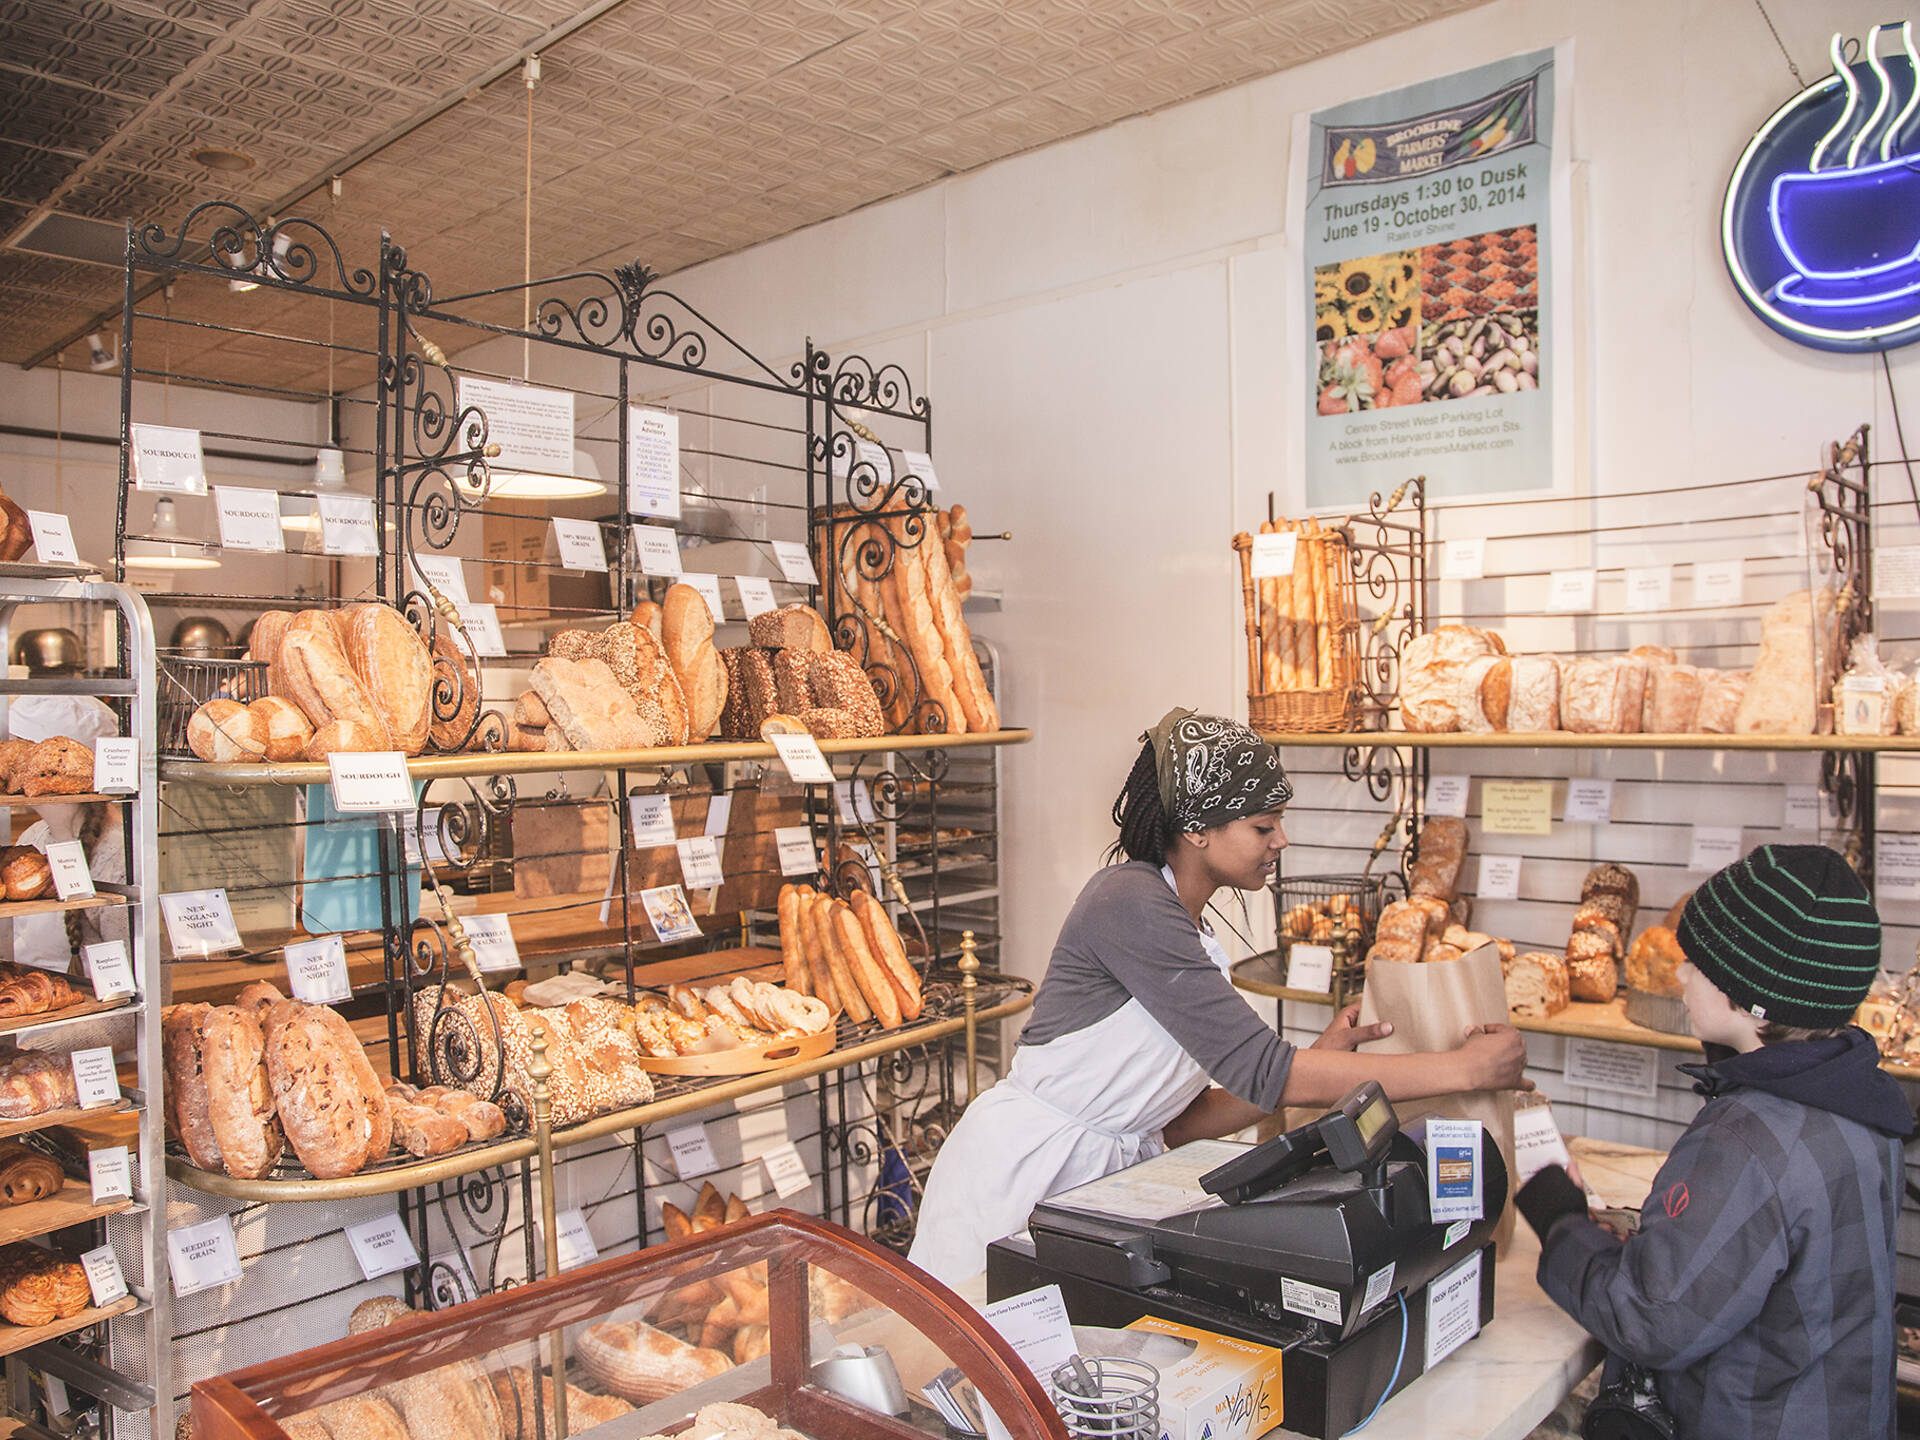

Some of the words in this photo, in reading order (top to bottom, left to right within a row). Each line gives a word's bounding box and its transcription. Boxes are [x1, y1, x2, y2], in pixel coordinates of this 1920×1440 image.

[1387, 119, 1462, 147] BROOKLINE
[1397, 133, 1449, 157] FARMERS'
[1400, 152, 1444, 173] MARKET
[1324, 190, 1410, 221] Thursdays
[1416, 178, 1452, 201] 1:30
[1457, 175, 1474, 193] to
[1481, 163, 1528, 187] Dusk
[1323, 220, 1358, 242] June
[1364, 216, 1380, 234] 19
[1393, 202, 1455, 228] October
[1460, 194, 1482, 215] 30,
[1487, 184, 1526, 208] 2014
[1387, 229, 1411, 243] Rain
[1413, 227, 1423, 238] or
[1425, 221, 1456, 235] Shine
[1344, 422, 1378, 436] Centre
[1380, 419, 1411, 432] Street
[1412, 415, 1439, 428] West
[1441, 410, 1483, 426] Parking
[1486, 408, 1504, 419] Lot
[1329, 441, 1337, 451] A
[1339, 438, 1363, 450] block
[1365, 436, 1389, 447] from
[1391, 430, 1432, 445] Harvard
[1434, 428, 1456, 440] and
[1458, 424, 1499, 438] Beacon
[143, 448, 197, 460] SOURDOUGH
[224, 510, 274, 520] SOURDOUGH
[325, 517, 371, 527] SOURDOUGH
[186, 904, 208, 912] NEW
[178, 912, 219, 921] ENGLAND
[186, 921, 214, 929] NIGHT
[307, 955, 324, 963] NEW
[300, 962, 335, 973] ENGLAND
[307, 970, 330, 980] NIGHT
[364, 1232, 391, 1244] SEEDED
[372, 1239, 395, 1249] GRAIN
[181, 1238, 215, 1253] SEEDED
[189, 1247, 216, 1261] GRAIN
[1216, 1338, 1263, 1354] Midget
